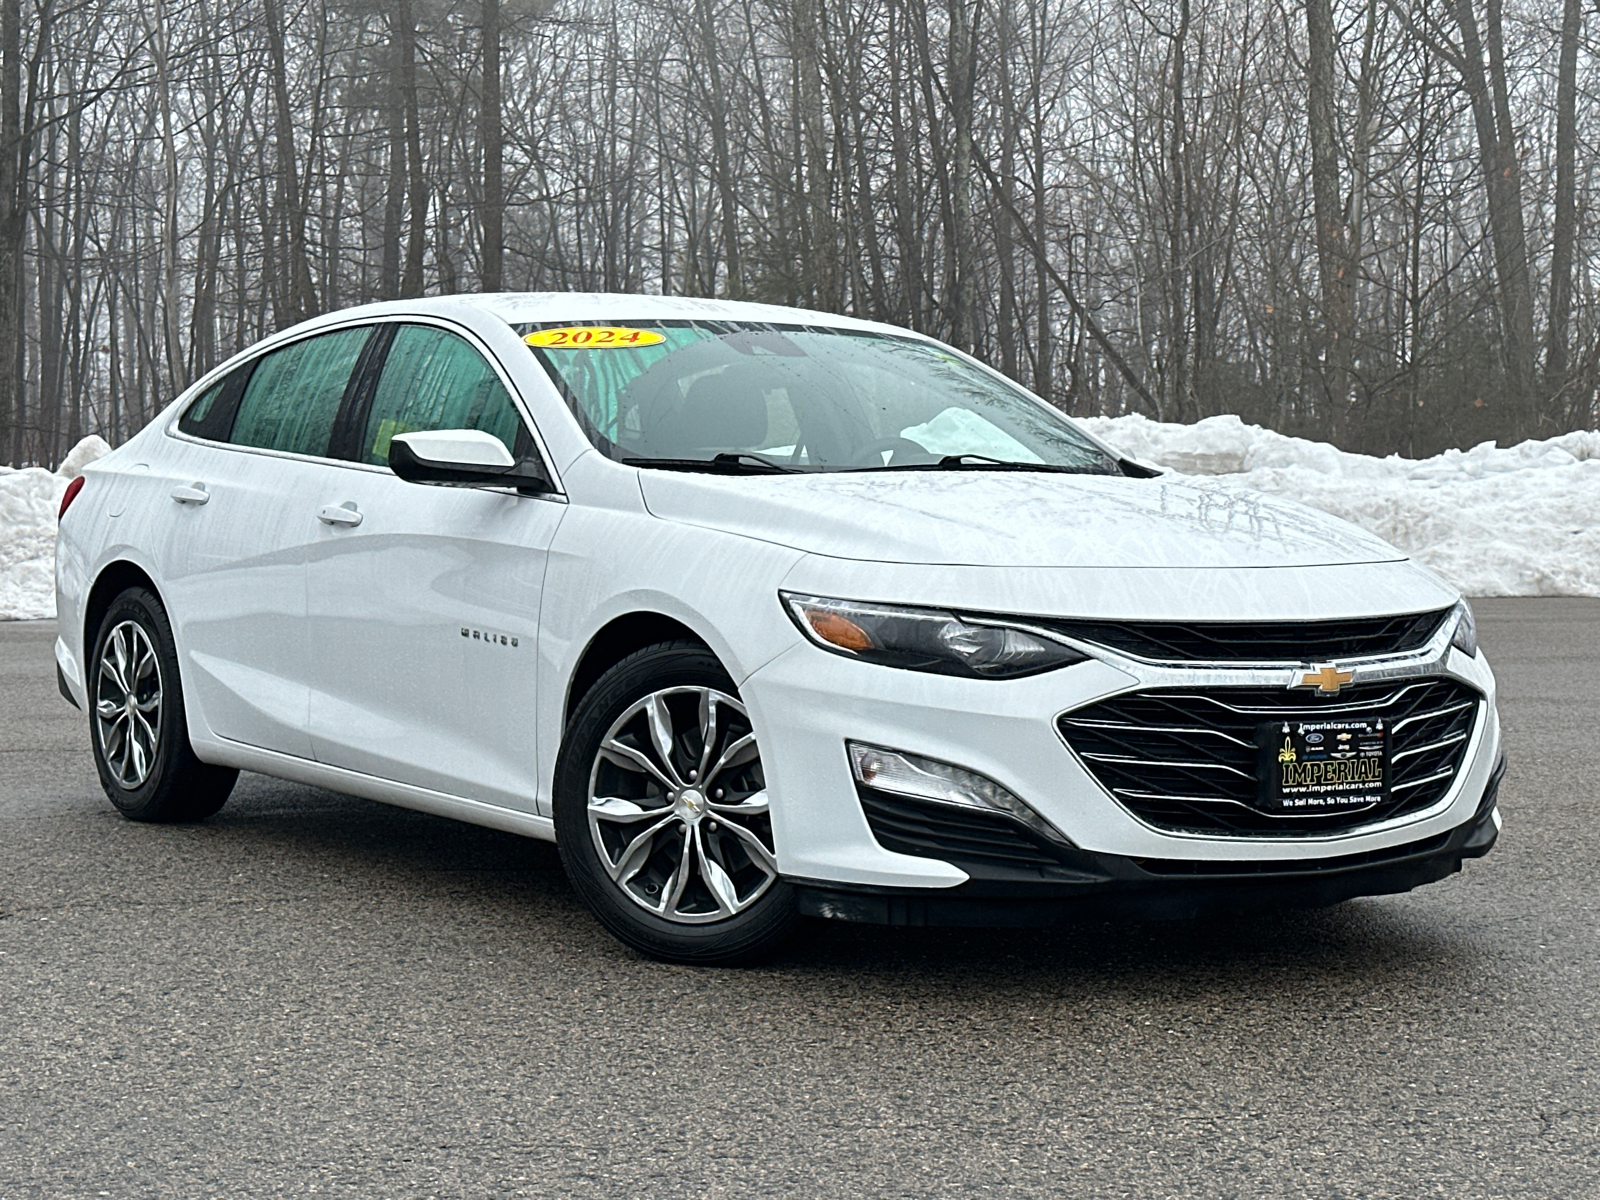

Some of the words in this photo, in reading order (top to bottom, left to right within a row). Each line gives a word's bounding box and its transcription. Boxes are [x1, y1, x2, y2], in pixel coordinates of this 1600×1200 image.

[548, 331, 640, 345] 2024
[1282, 758, 1382, 785] IMPERIAL
[1282, 799, 1293, 807] We
[1336, 796, 1348, 804] You
